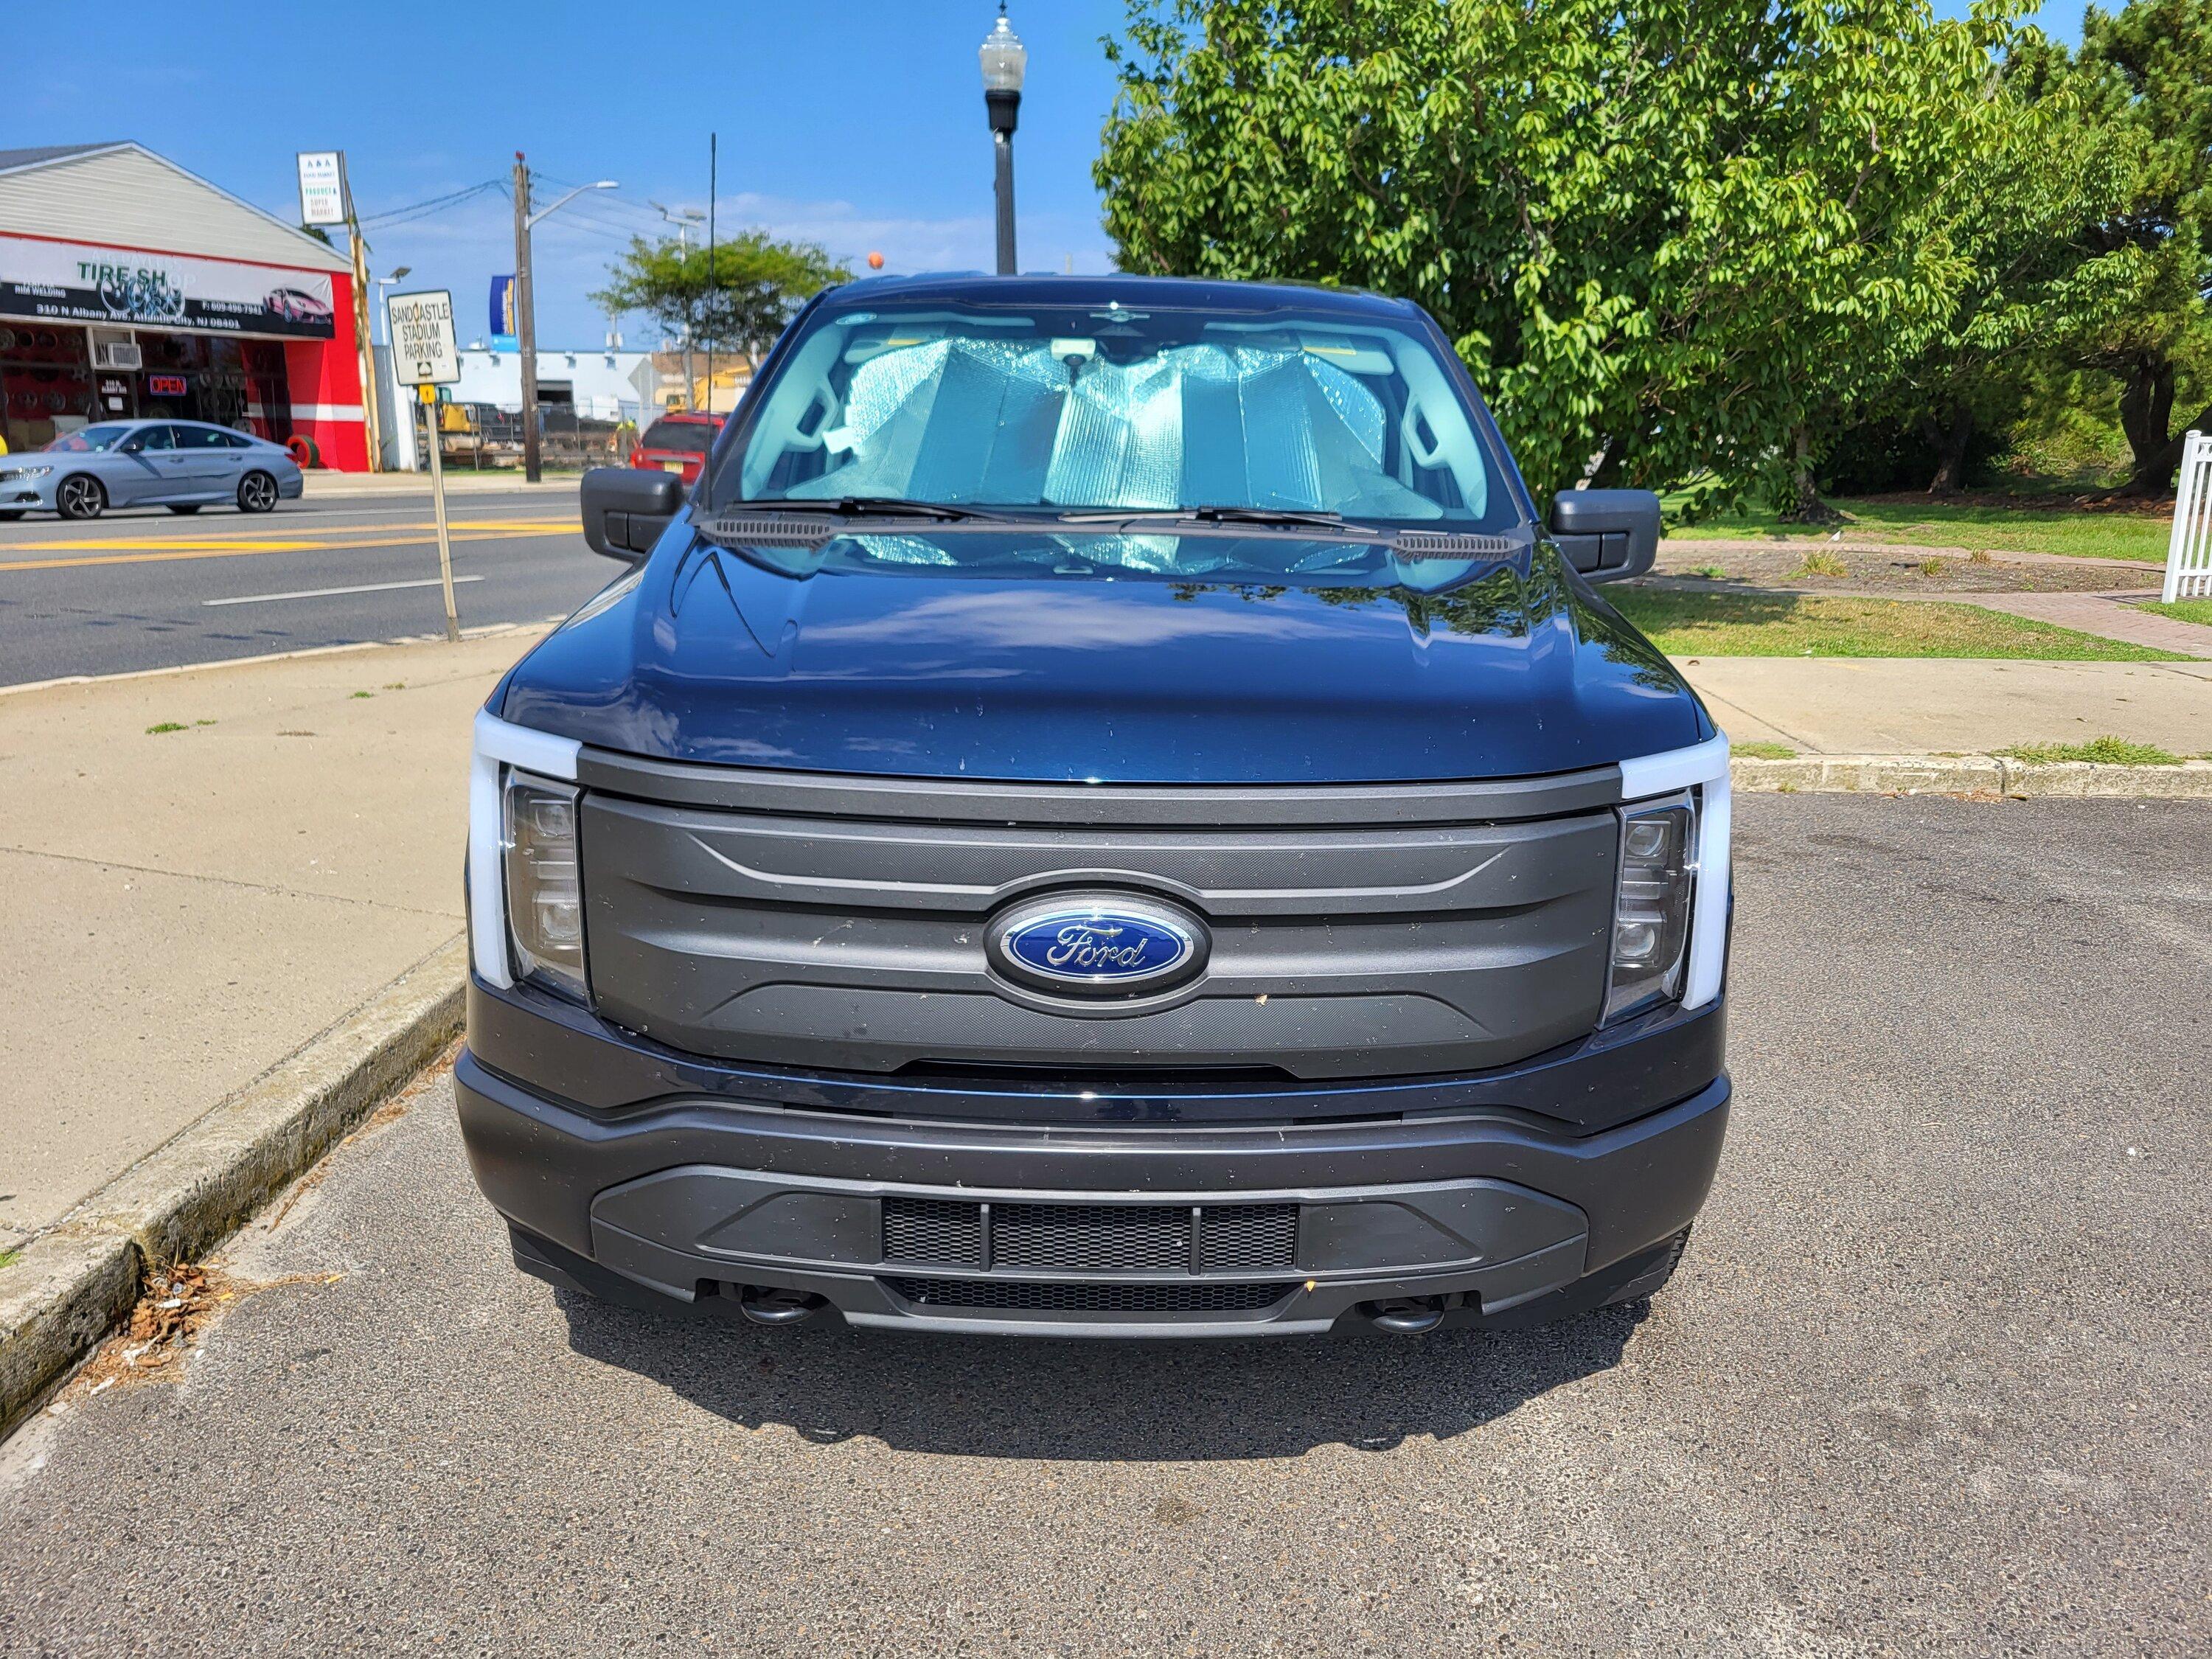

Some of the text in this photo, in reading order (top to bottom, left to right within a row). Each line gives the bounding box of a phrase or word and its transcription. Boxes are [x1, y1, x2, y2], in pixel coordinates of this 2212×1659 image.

[77, 261, 131, 282] TIRE
[32, 285, 66, 298] WELDING
[37, 304, 58, 316] 310
[61, 305, 69, 316] N
[72, 307, 107, 320] Albany
[133, 311, 172, 324] Atlantic
[197, 316, 208, 326] NJ
[209, 318, 240, 329] 08401
[392, 302, 450, 324] SANDCASTLE
[402, 322, 441, 341] STADIUM
[404, 341, 443, 360] PARKING
[152, 378, 185, 393] OPEN
[1046, 925, 1148, 967] Ford
